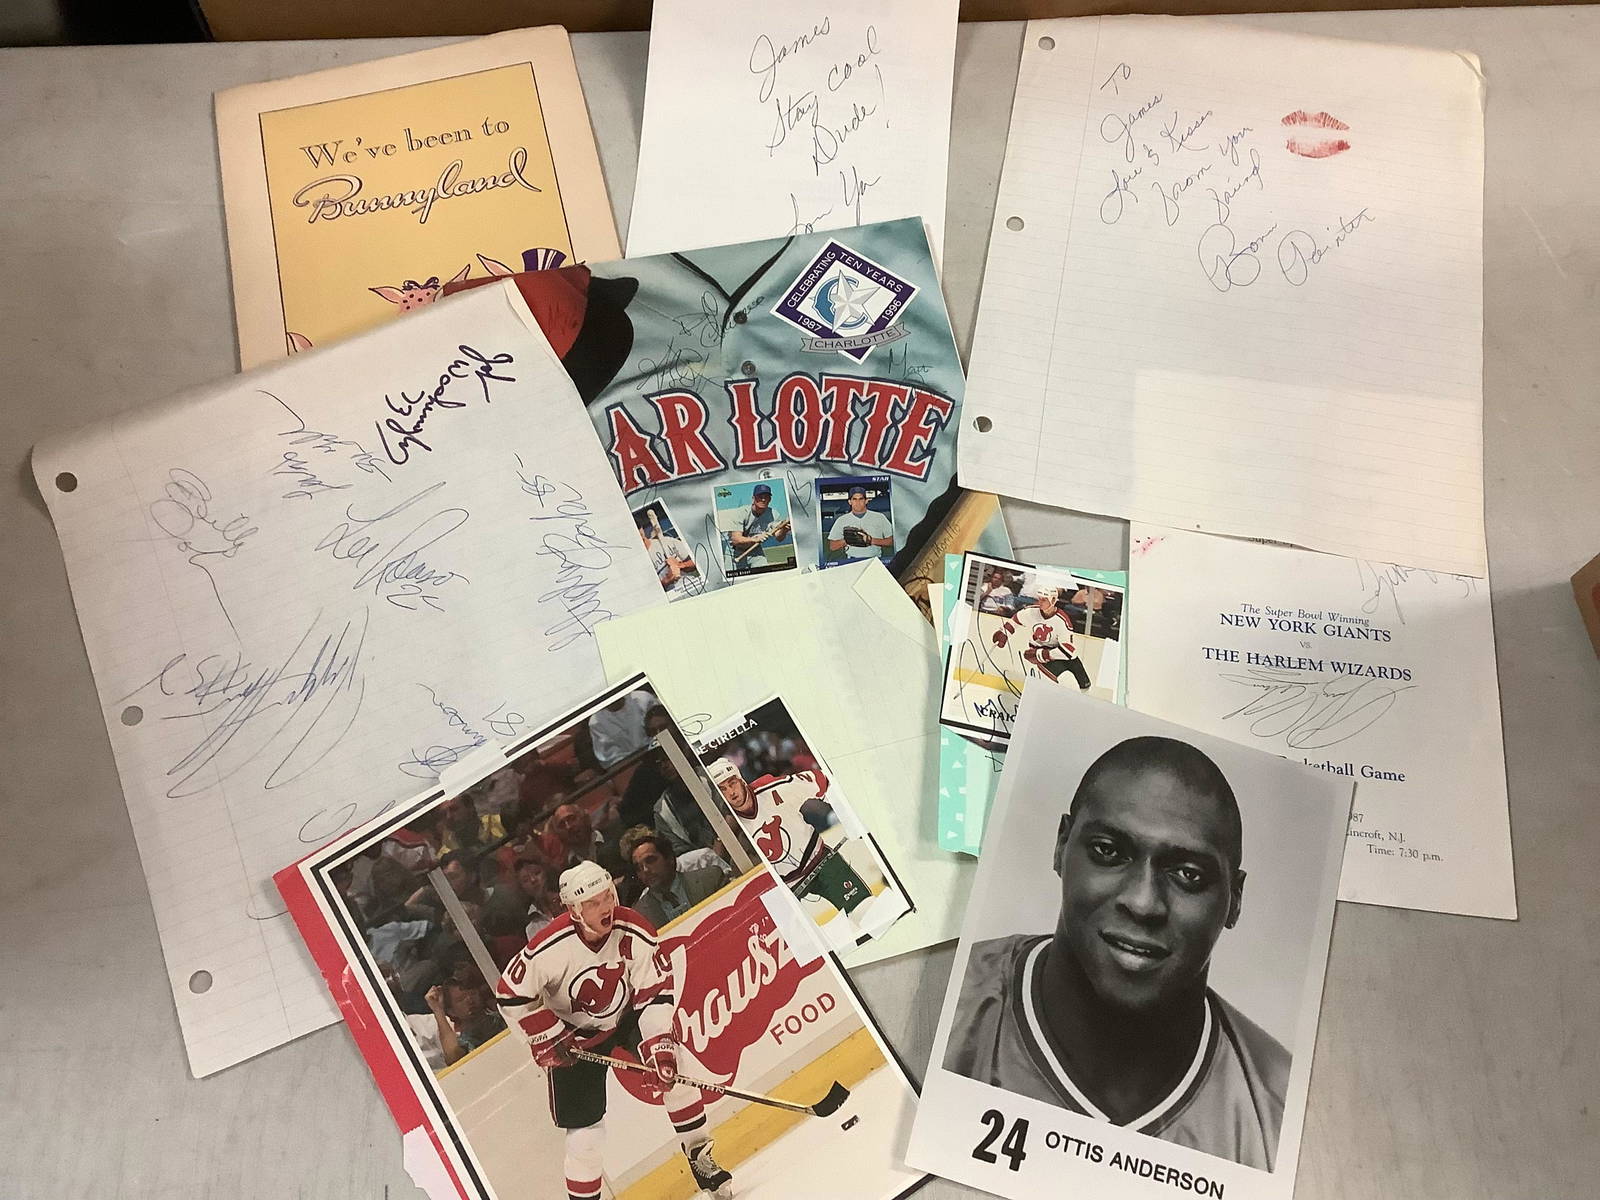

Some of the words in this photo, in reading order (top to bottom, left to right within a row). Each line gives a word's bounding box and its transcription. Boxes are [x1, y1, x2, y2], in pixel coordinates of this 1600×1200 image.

[749, 16, 831, 103] James
[299, 137, 397, 169] We've
[403, 127, 472, 153] been
[481, 115, 511, 138] to
[293, 146, 542, 224] Bunnyland
[787, 250, 836, 308] CELEBRATING
[839, 251, 863, 270] TEN
[866, 267, 904, 293] YEARS
[797, 315, 823, 332] 1987
[881, 299, 902, 321] 1996
[814, 328, 897, 349] CHARLOTTE
[1219, 613, 1261, 628] NEW
[1267, 618, 1317, 635] YORK
[1323, 624, 1392, 642] GIANTS
[1240, 603, 1261, 615] The
[1265, 605, 1293, 618] Super
[1297, 608, 1322, 620] Bowl
[1328, 612, 1370, 627] Winning
[1202, 647, 1240, 663] THE
[1246, 652, 1324, 672] HARLEM
[1330, 661, 1412, 682] WIZARDS
[708, 719, 758, 749] CIRELLA
[1361, 765, 1406, 782] Game
[1346, 829, 1385, 841] incroft,
[1388, 831, 1406, 843] N.J.
[1366, 843, 1395, 856] Time:
[1399, 847, 1419, 859] 7:30
[1422, 852, 1444, 862] p.m.
[769, 992, 836, 1045] FOOD
[971, 1108, 1030, 1172] 24
[1045, 1131, 1104, 1163] OTTIS
[1109, 1151, 1225, 1200] ANDERSON
